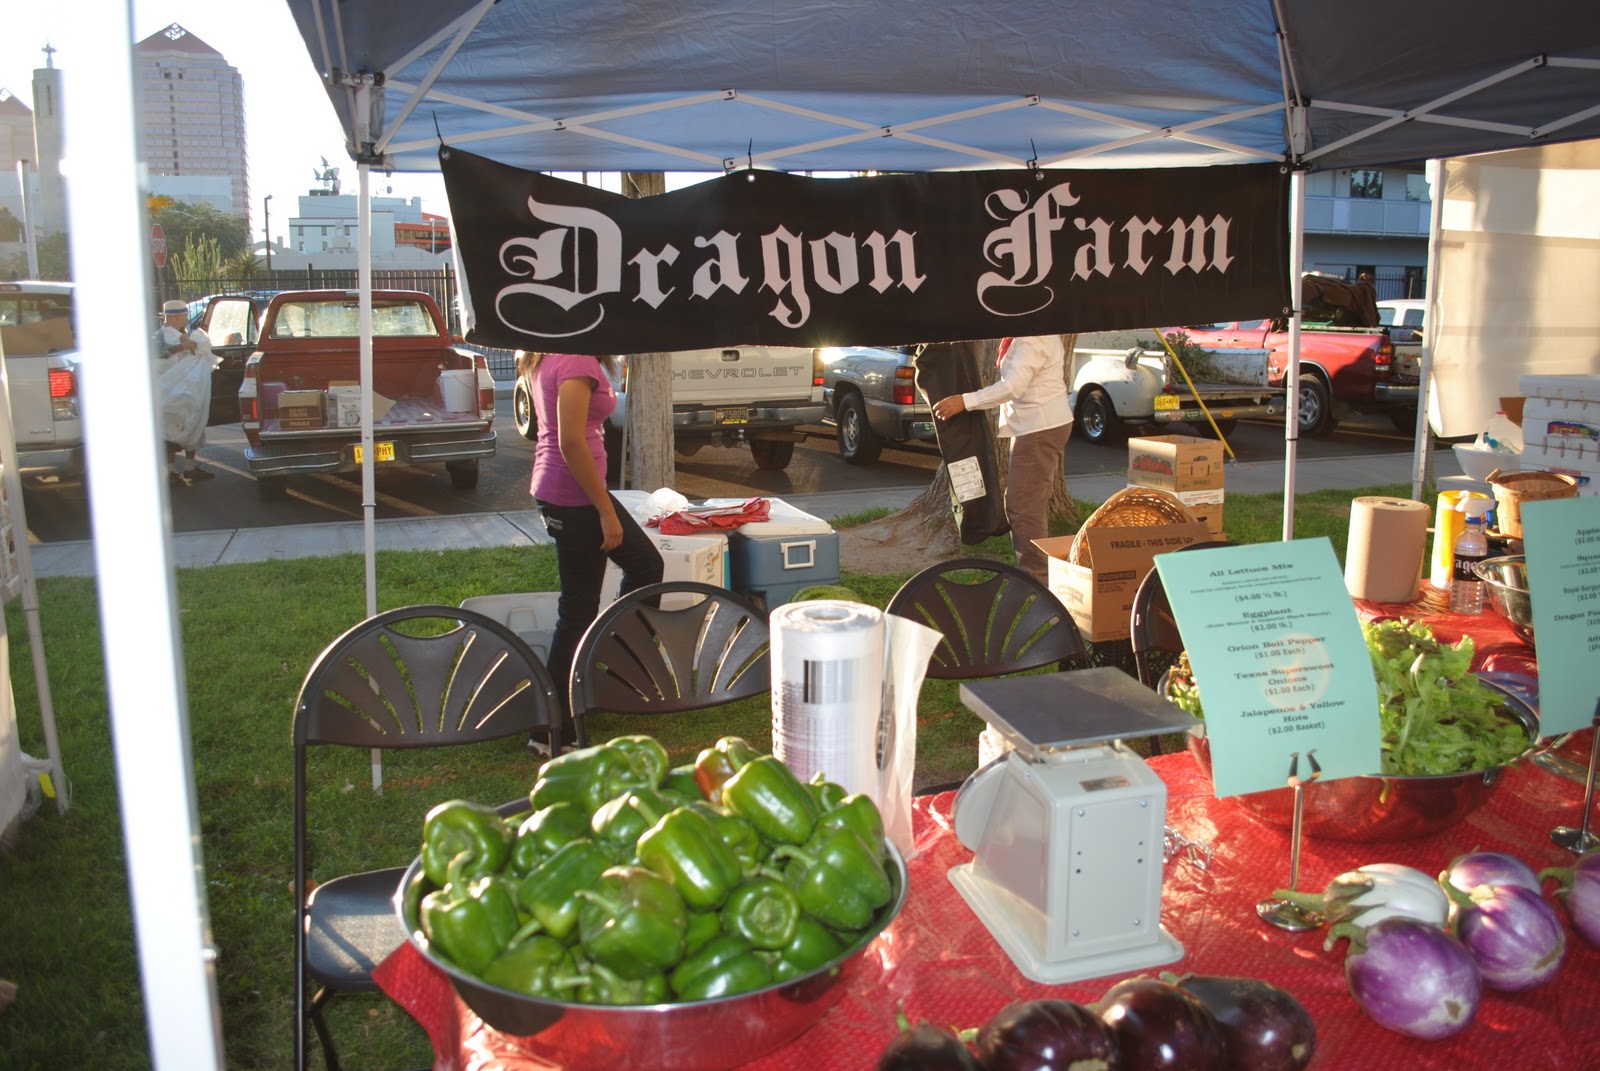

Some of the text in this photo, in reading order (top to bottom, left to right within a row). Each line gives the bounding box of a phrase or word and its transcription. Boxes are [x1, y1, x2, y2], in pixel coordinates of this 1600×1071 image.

[495, 182, 1235, 337] Dragon Farm
[671, 366, 804, 380] HEVROLET
[1111, 540, 1141, 549] FRAGILE
[1146, 538, 1164, 547] THIS
[1165, 537, 1182, 545] SIDE
[1228, 566, 1268, 575] Lettuce
[1271, 563, 1294, 571] Mix
[1098, 571, 1135, 582] FOODSERVICE
[1242, 608, 1292, 619] Eggplant
[1553, 613, 1585, 621] Dragon
[1227, 644, 1259, 652] Orion
[1287, 636, 1326, 646] Pepper
[1283, 646, 1305, 655] Each)
[1234, 662, 1335, 680] Texas Supersweet
[1268, 676, 1307, 685] Onions
[1293, 683, 1315, 692] Each)
[1240, 705, 1296, 718] Jalapenos
[1308, 700, 1345, 709] Yellow
[1283, 714, 1309, 723] Hots
[1296, 721, 1325, 731] Basket)
